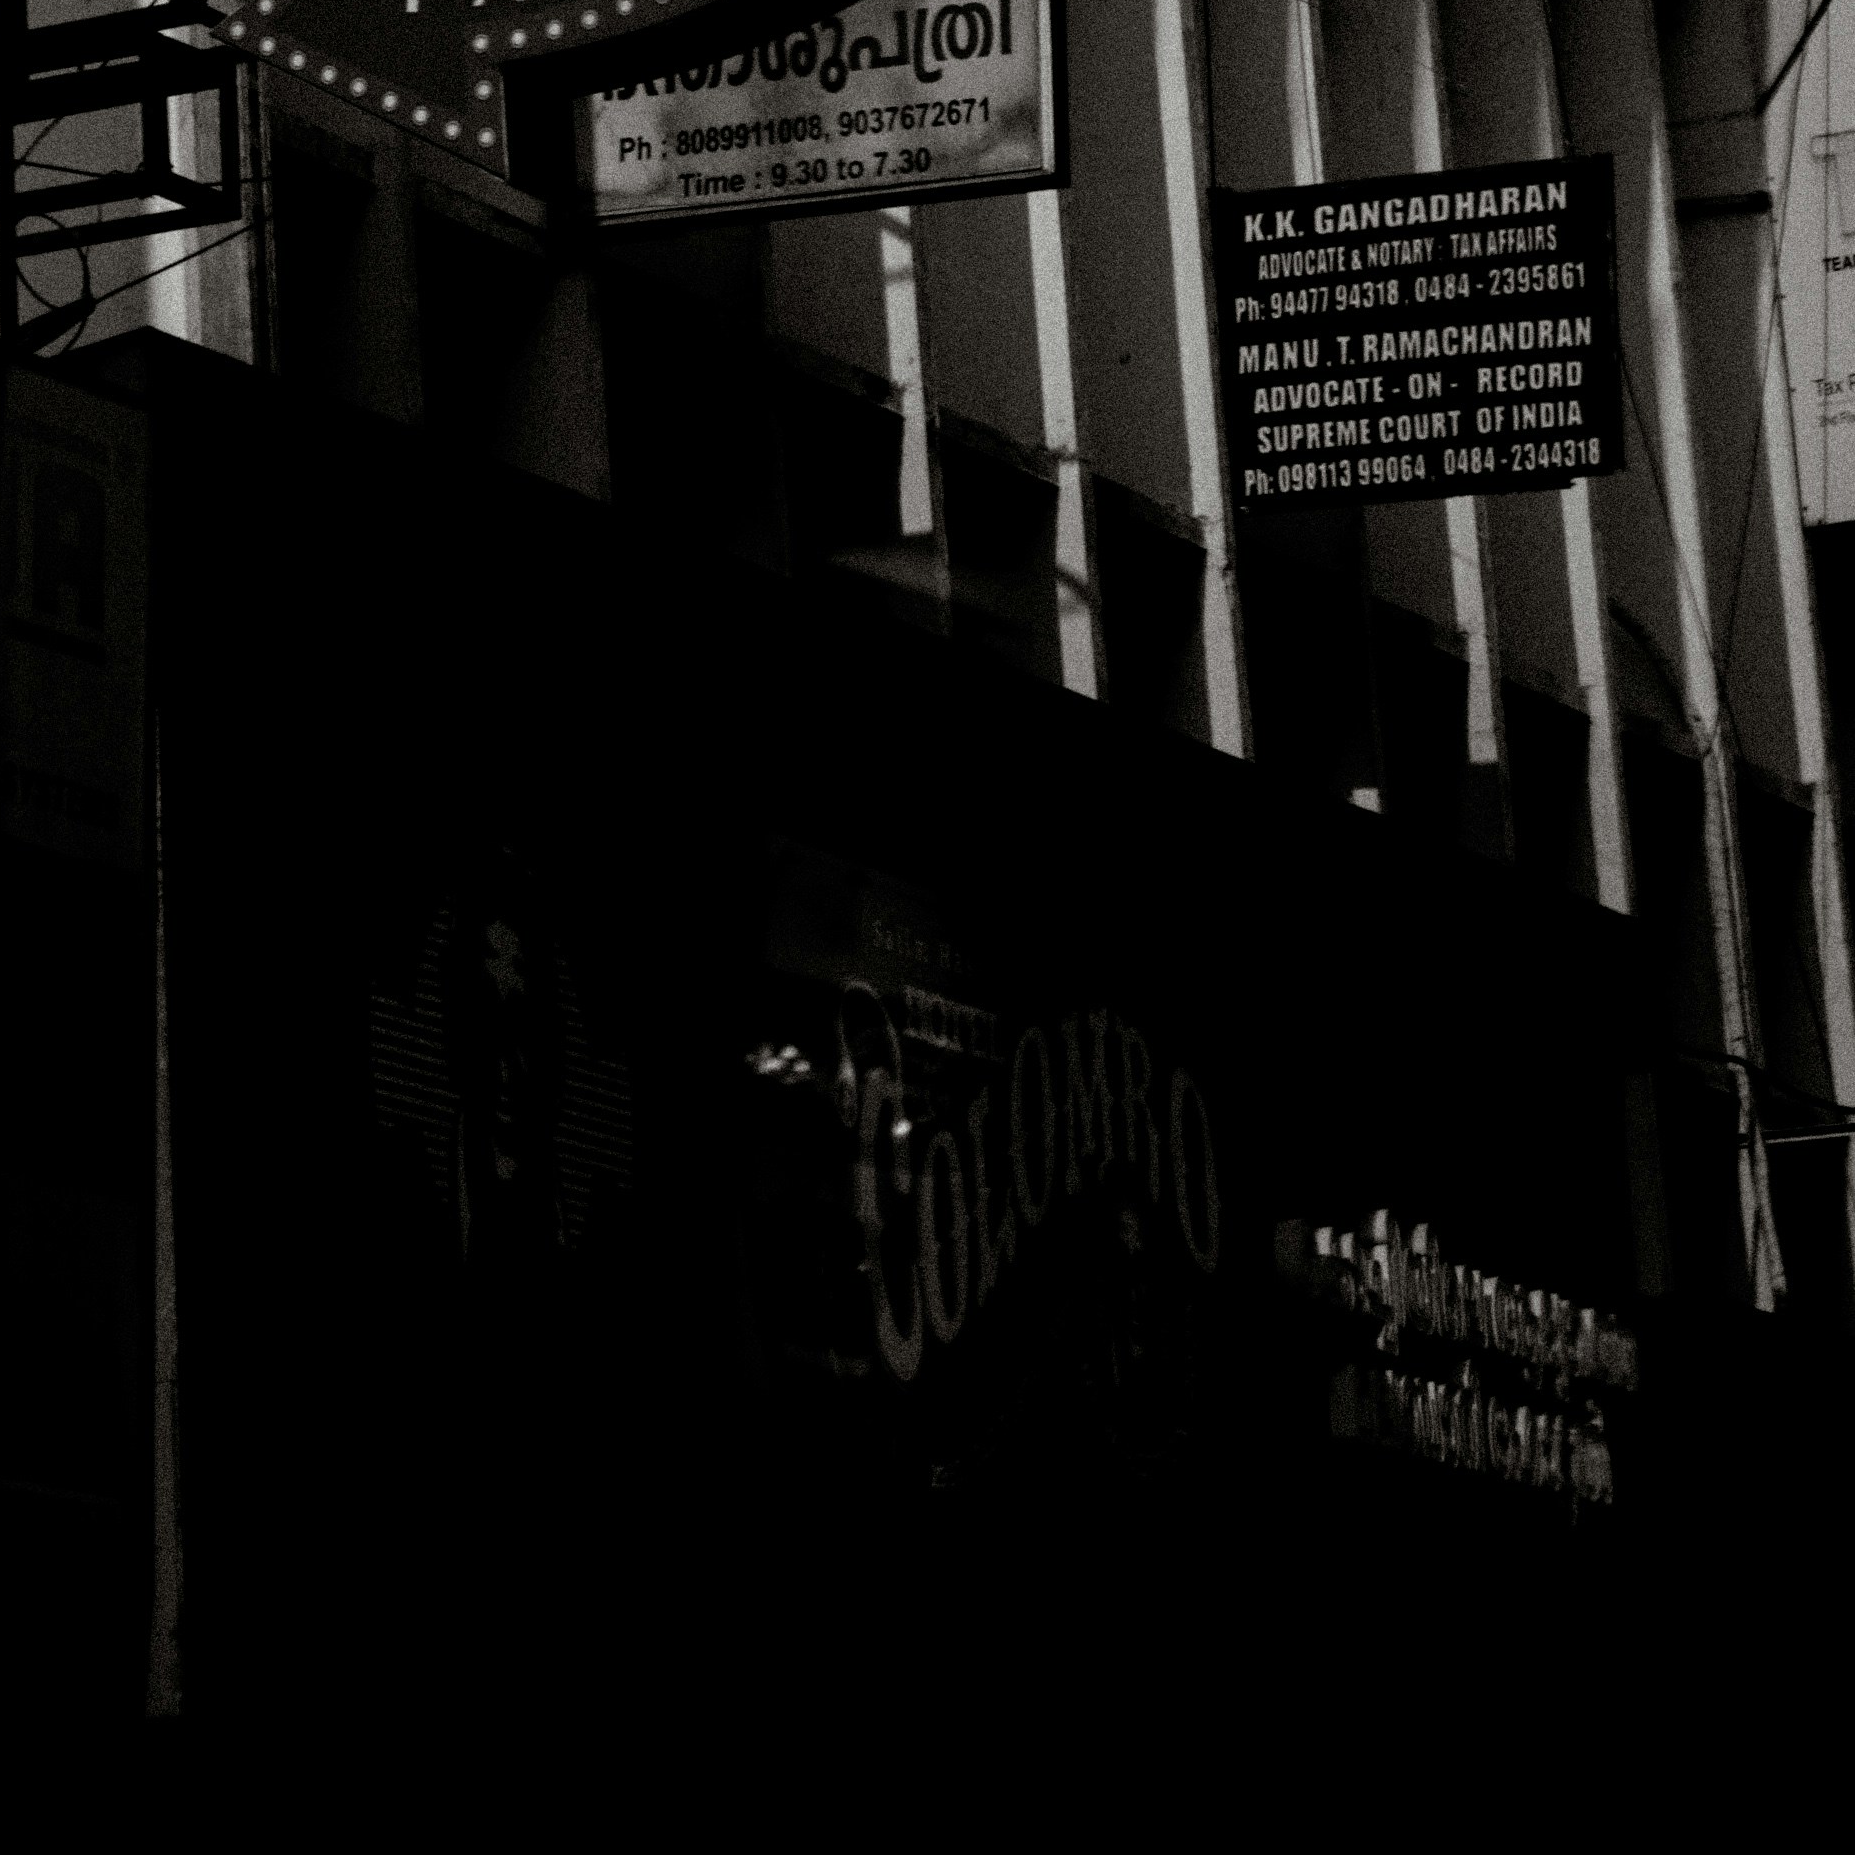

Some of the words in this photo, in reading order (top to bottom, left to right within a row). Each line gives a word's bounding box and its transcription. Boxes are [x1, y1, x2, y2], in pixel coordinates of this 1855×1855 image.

[838, 96, 989, 138] 9037672671
[679, 171, 745, 198] Time
[770, 158, 828, 188] 9.30
[836, 157, 865, 180] to
[873, 147, 932, 177] 7.30
[1244, 209, 1306, 244] K.K.
[1313, 180, 1568, 235] GANGADHARAN
[1257, 245, 1347, 281] ADVOCATE
[1350, 248, 1364, 272] &
[1449, 231, 1483, 260] TAX
[1486, 223, 1558, 257] AFFAIRS
[1269, 286, 1330, 320] 94477
[1362, 316, 1593, 364] RAMACHANDRAN
[1253, 376, 1386, 415] ADVOCATE
[1407, 370, 1443, 402] ON
[1476, 360, 1584, 394] RECORD
[1256, 418, 1372, 455] SUPREME
[1377, 409, 1462, 444] COURT
[1475, 405, 1506, 434] OF
[1511, 399, 1584, 431] INDIA
[1277, 459, 1352, 493] 098113
